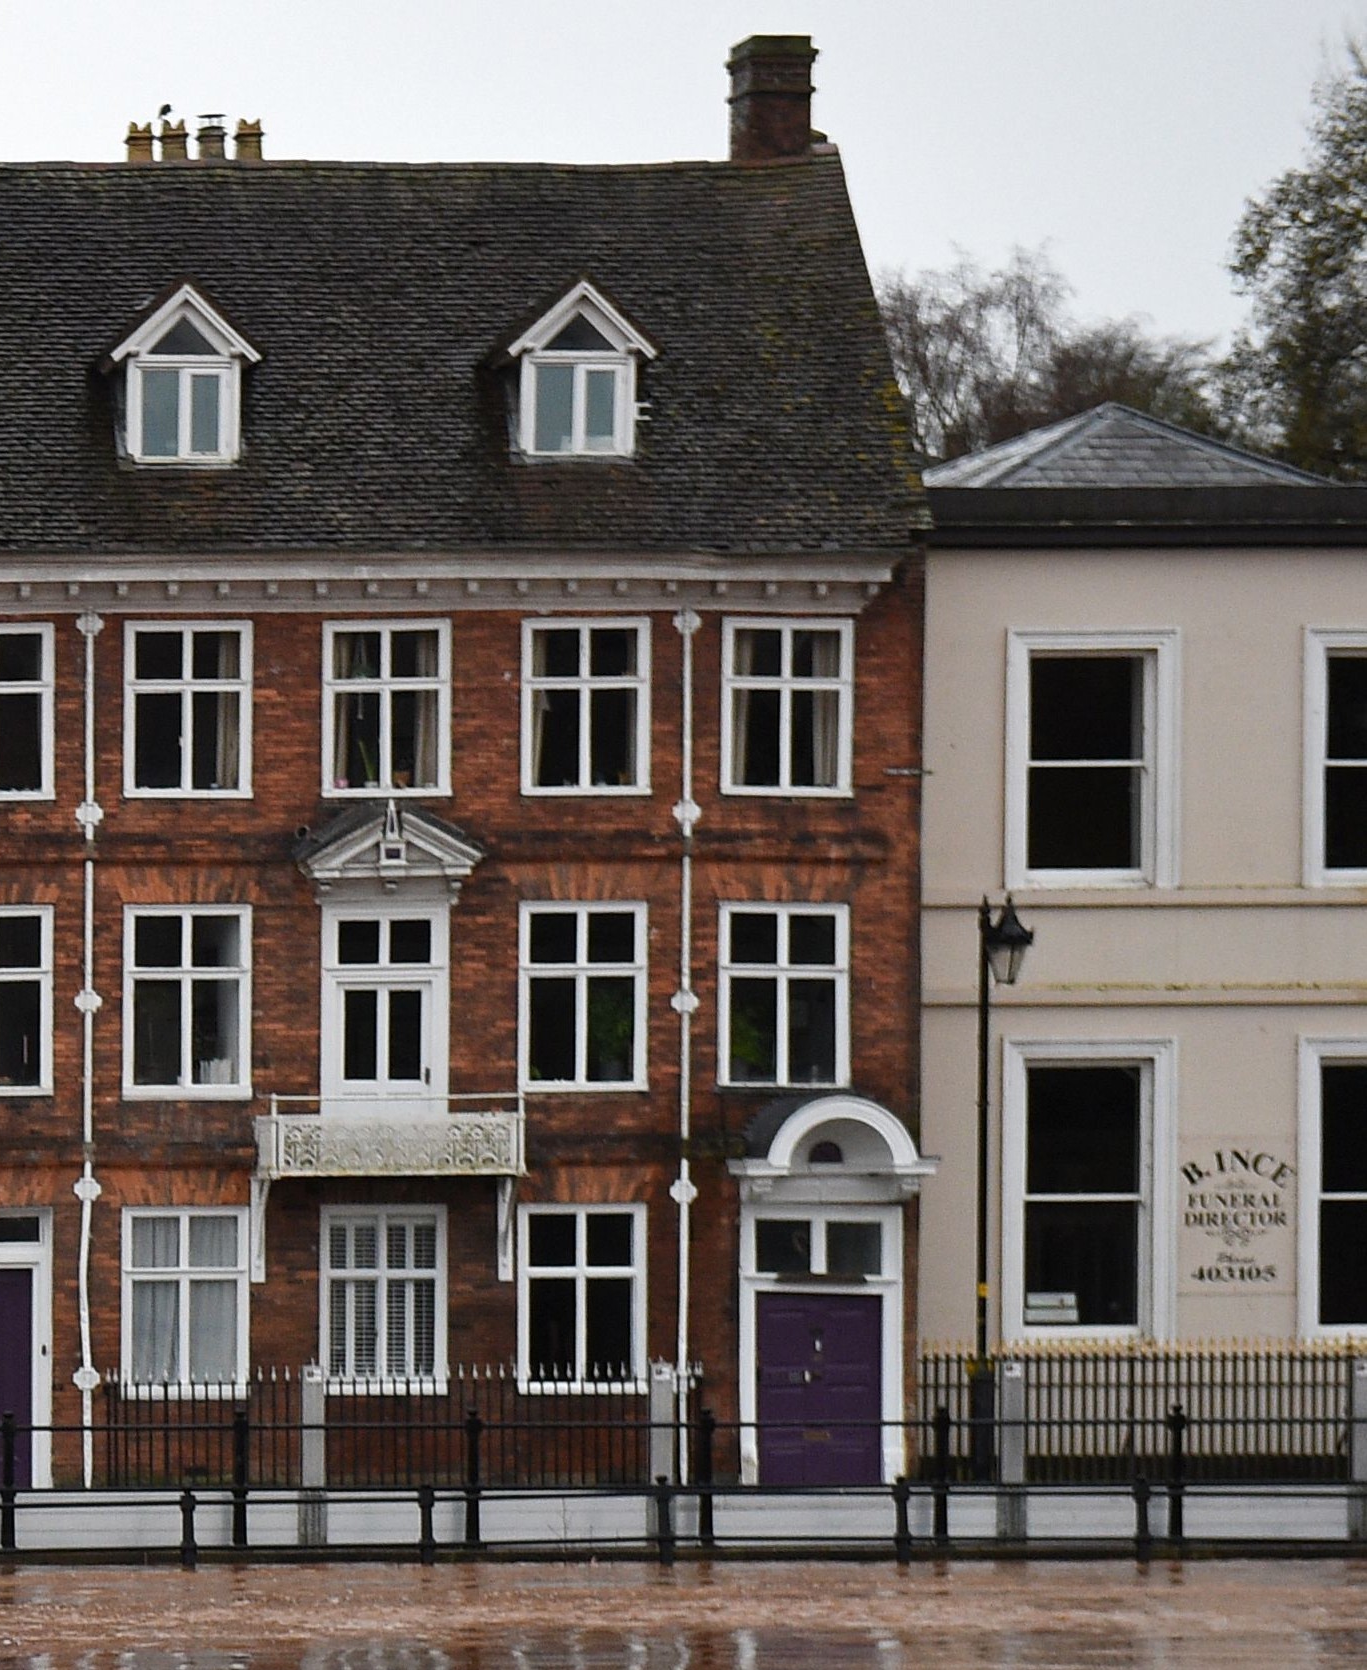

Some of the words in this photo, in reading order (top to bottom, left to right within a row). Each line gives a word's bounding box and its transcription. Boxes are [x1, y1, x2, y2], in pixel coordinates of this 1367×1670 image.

[1181, 1161, 1211, 1185] B.
[1215, 1150, 1297, 1189] INCE
[1187, 1193, 1281, 1209] FUNERAL
[1184, 1211, 1287, 1227] DIRECTOR
[1191, 1265, 1277, 1282] 403105
